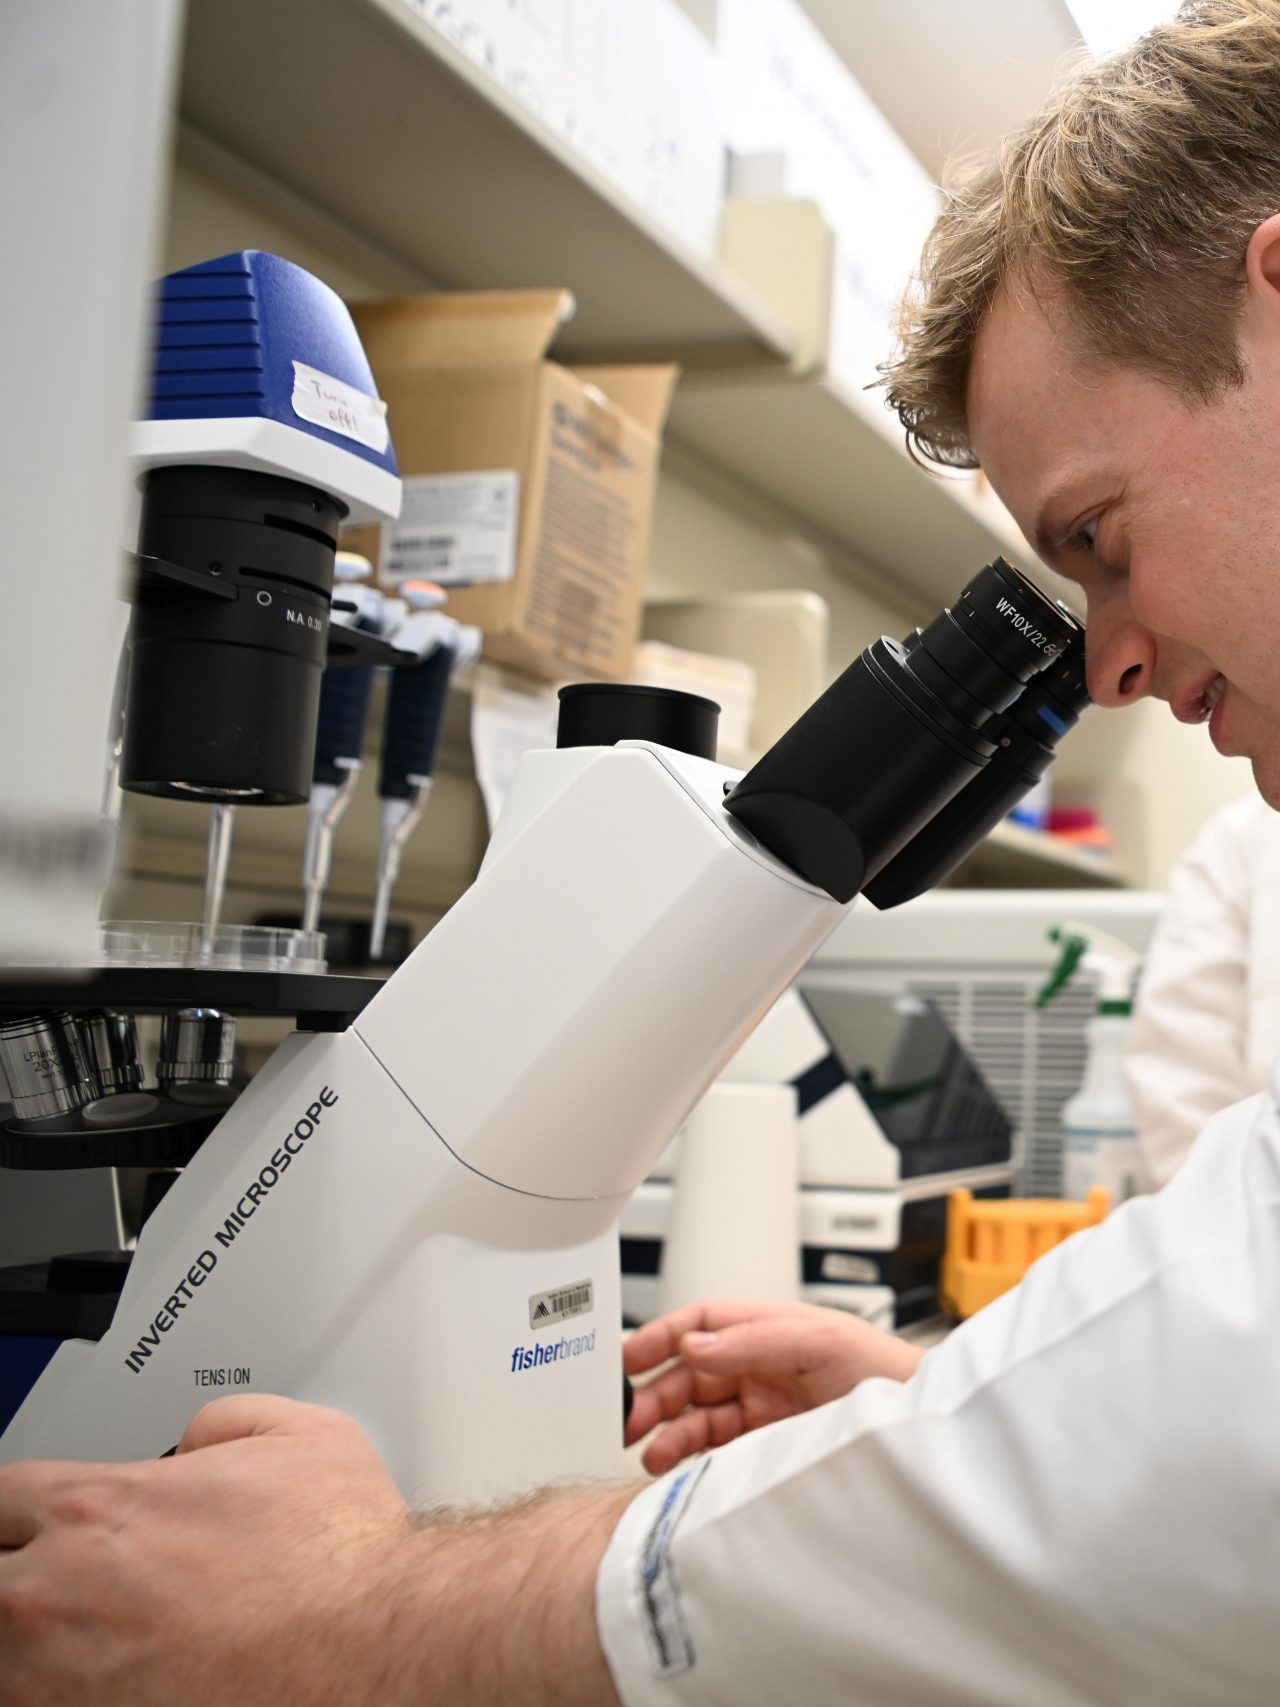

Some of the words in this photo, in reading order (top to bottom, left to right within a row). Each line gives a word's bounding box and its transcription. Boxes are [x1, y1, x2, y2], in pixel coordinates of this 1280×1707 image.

[995, 596, 1048, 649] WF10X/22
[125, 1249, 218, 1374] INVERTED
[214, 1085, 340, 1249] MICROSCOPE
[510, 1327, 597, 1373] fisherbrand
[193, 1367, 251, 1387] TENSION
